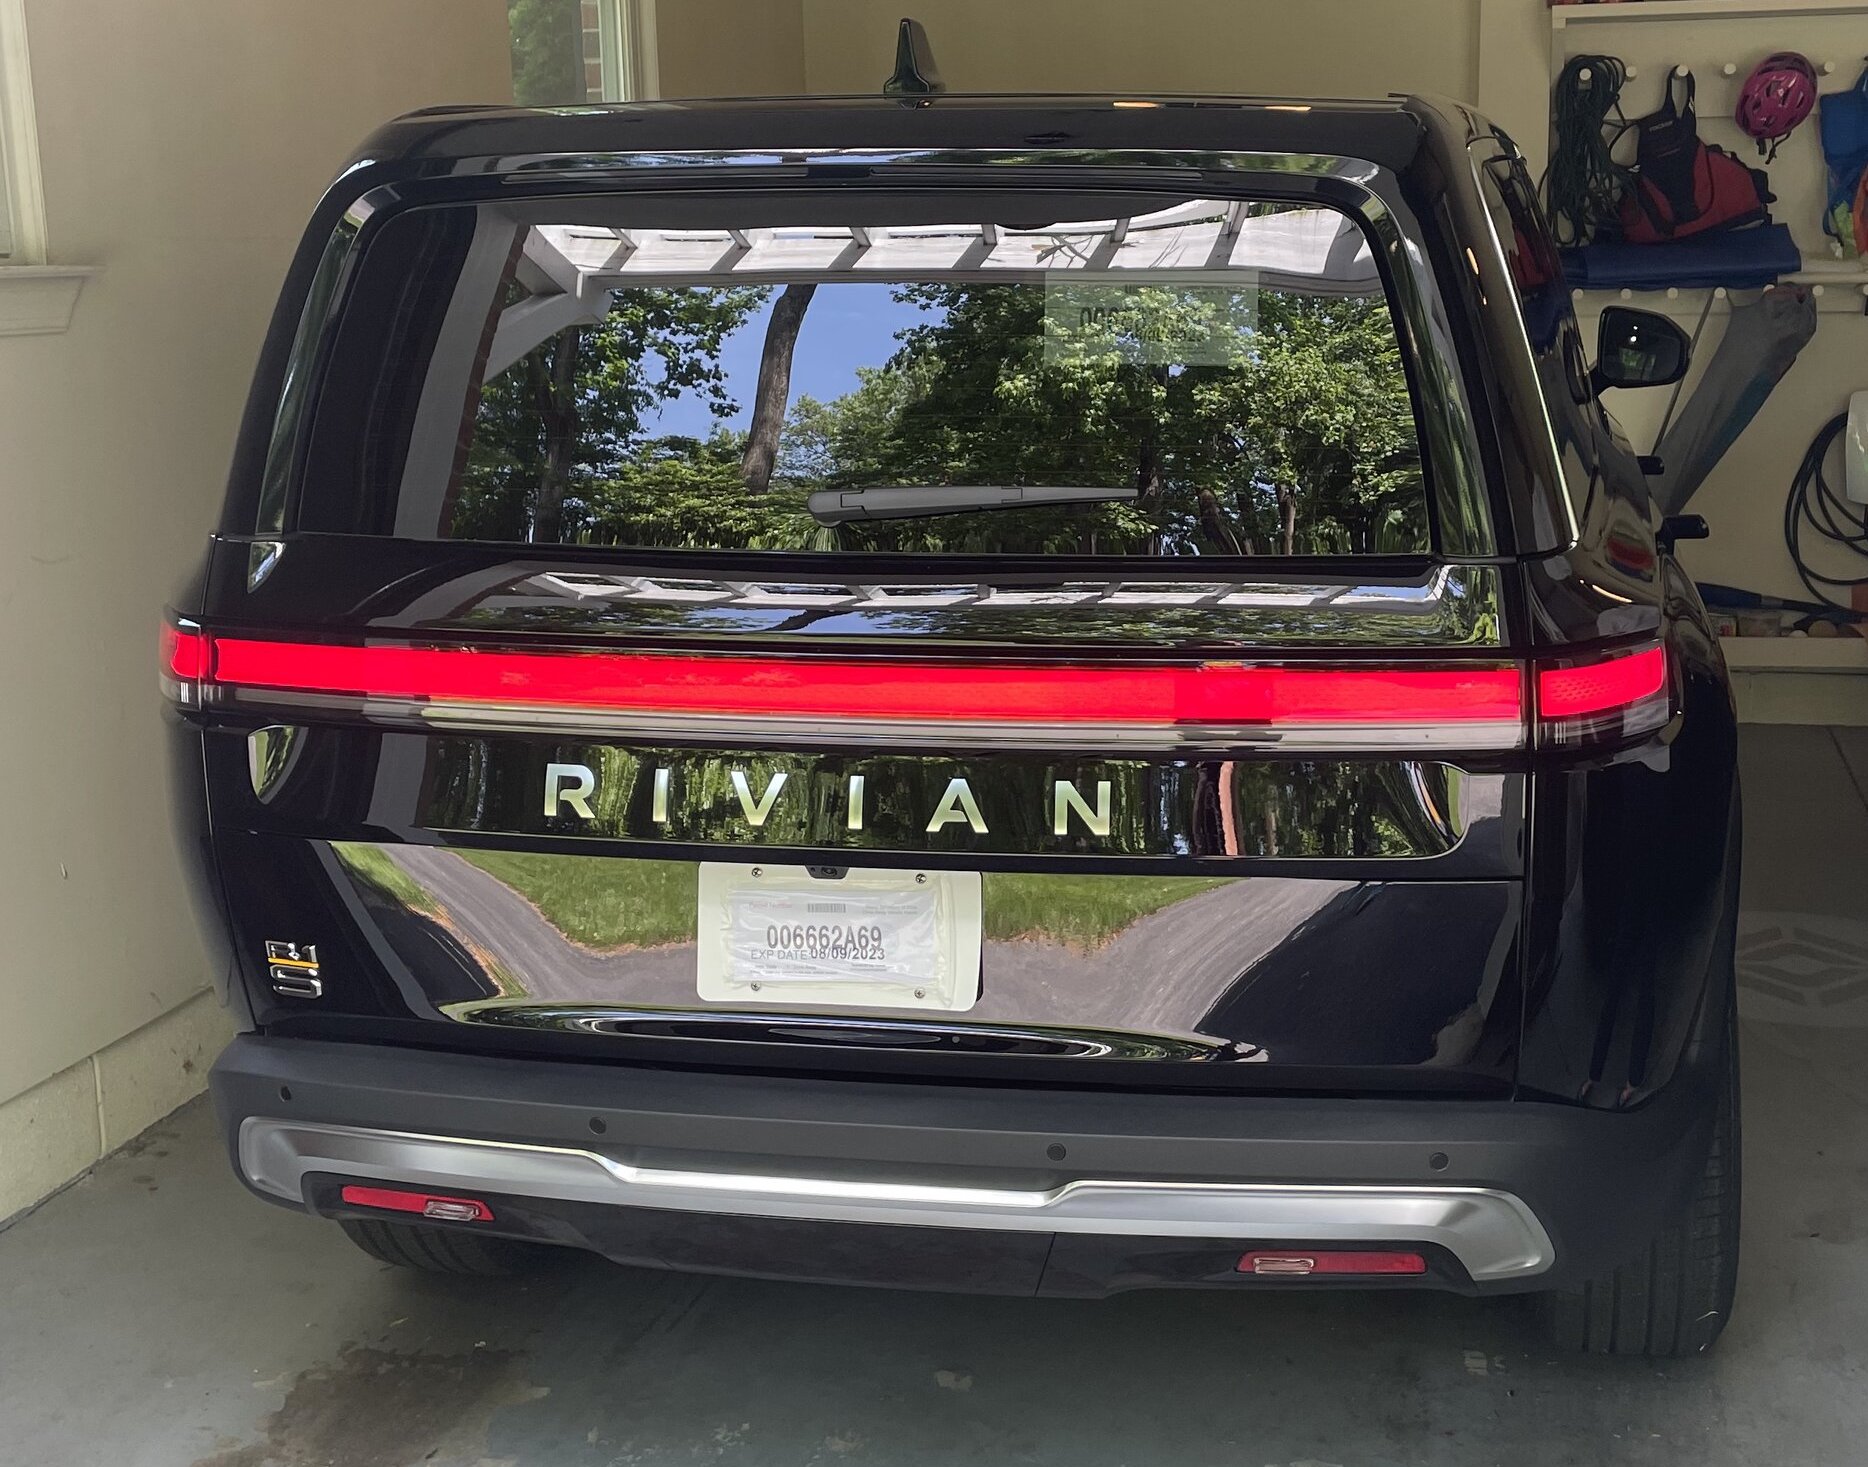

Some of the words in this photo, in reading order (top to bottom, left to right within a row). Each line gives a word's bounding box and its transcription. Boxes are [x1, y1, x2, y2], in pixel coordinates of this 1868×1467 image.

[544, 763, 1111, 835] RIVIAN
[766, 925, 882, 949] 006662A69
[751, 949, 774, 960] EXP
[811, 947, 885, 960] 08/09/2023
